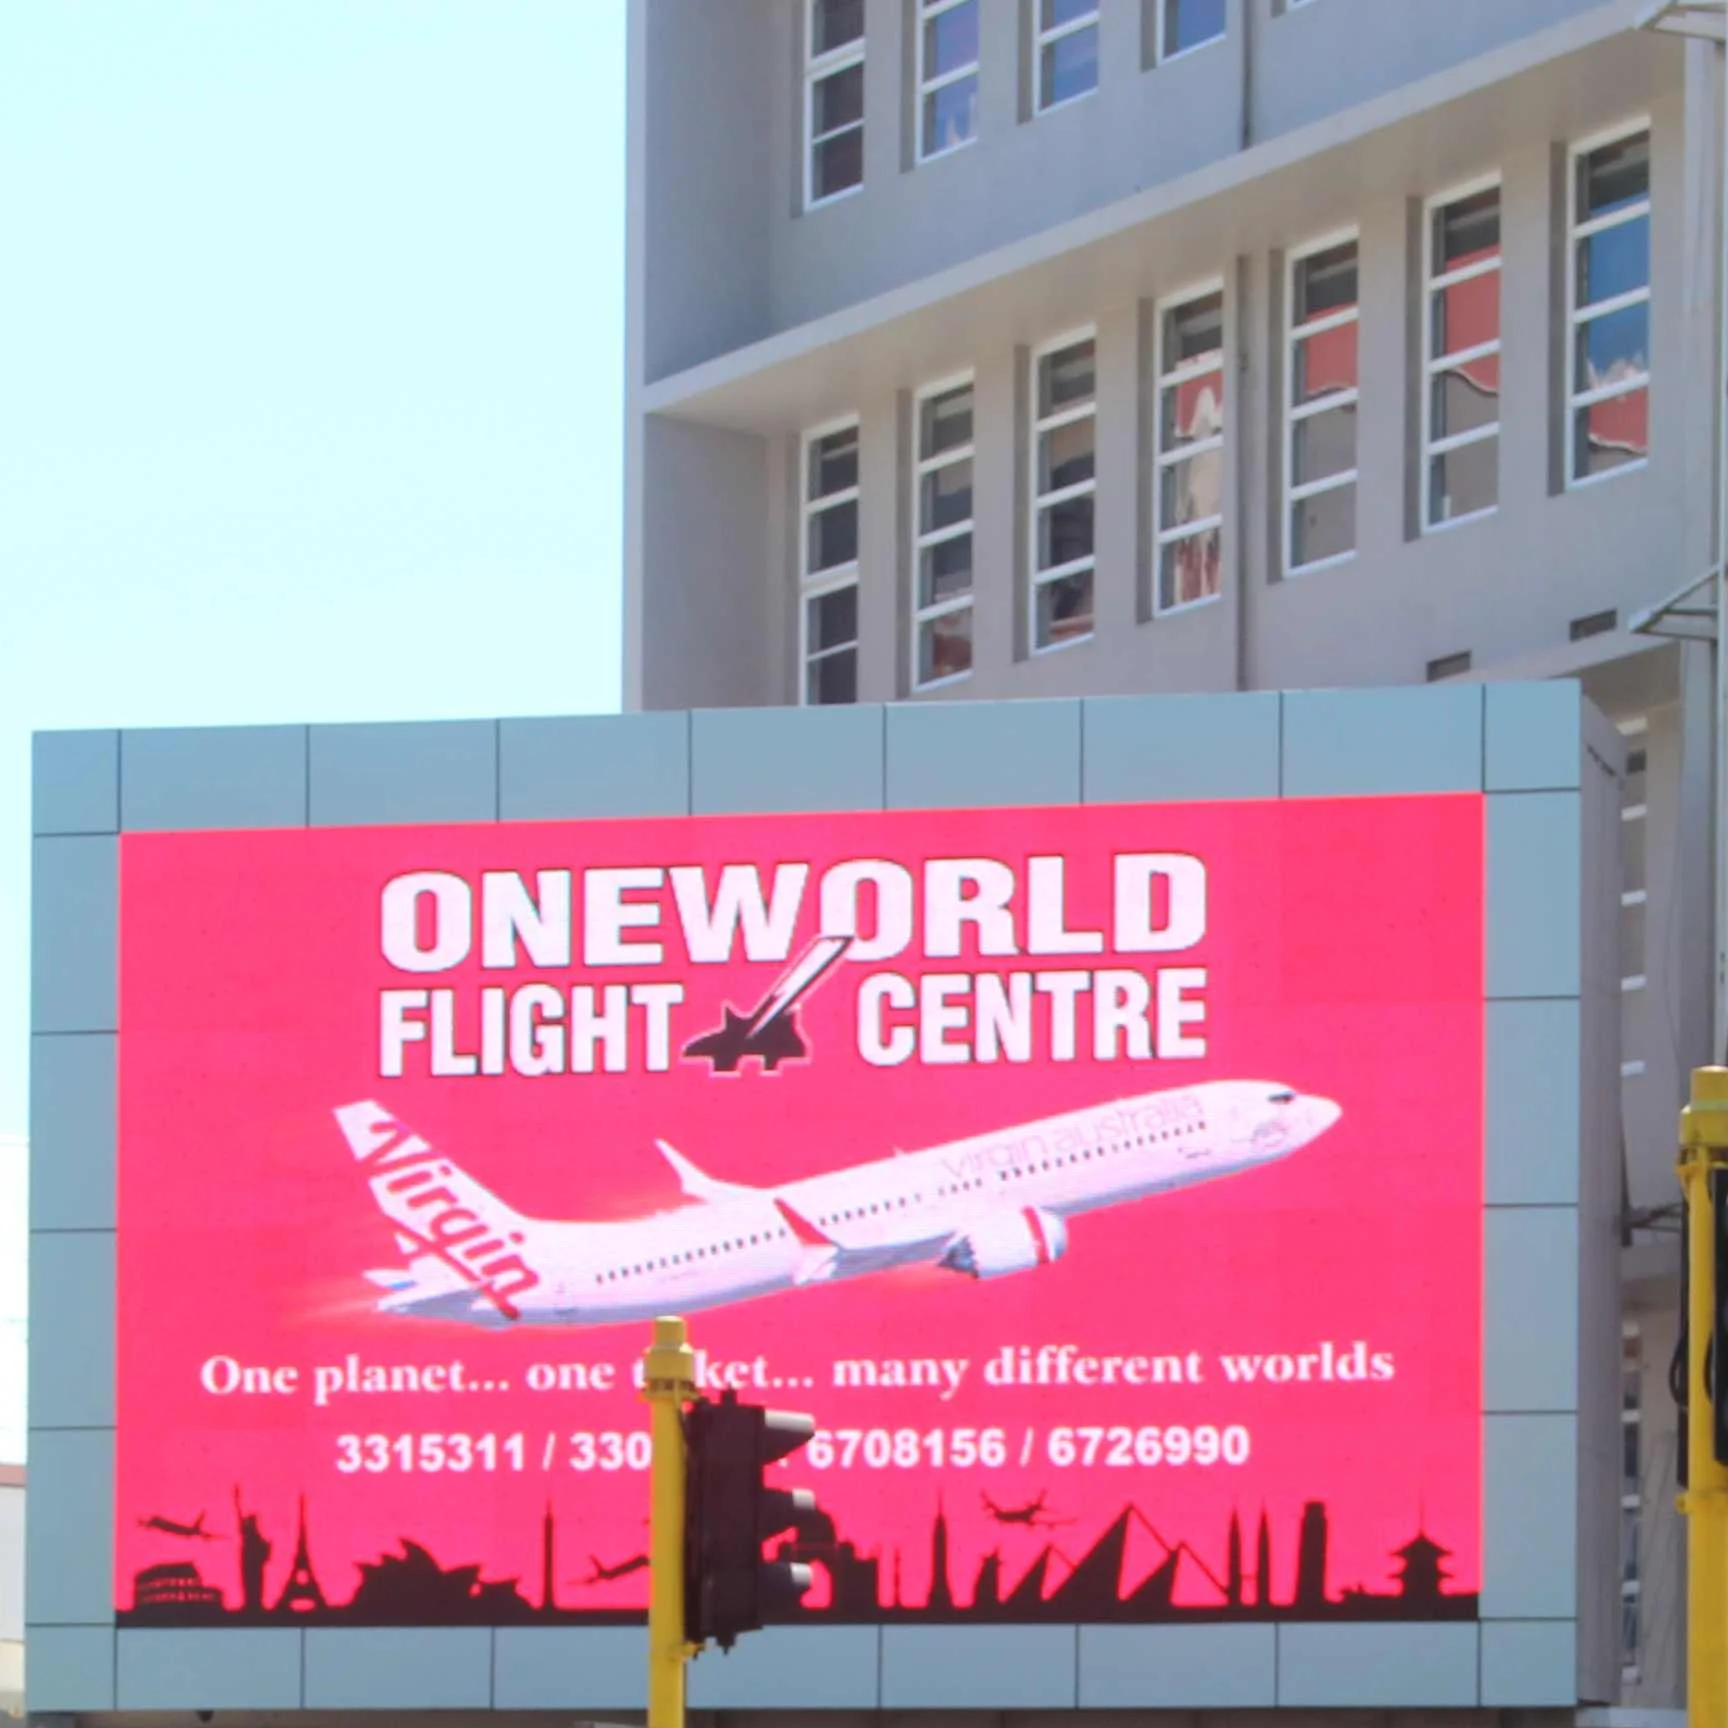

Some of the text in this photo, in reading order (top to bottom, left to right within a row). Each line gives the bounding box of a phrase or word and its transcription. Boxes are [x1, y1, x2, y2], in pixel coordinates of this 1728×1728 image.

[379, 852, 1207, 973] ONEWORLD
[378, 967, 1208, 1077] FLIGHT CENTRE
[362, 1121, 541, 1318] Virgin
[200, 1341, 1394, 1405] One planet... one tket... many different worlds
[335, 1433, 526, 1472] 3315311
[807, 1427, 1007, 1468] 6708156
[1047, 1425, 1250, 1465] 6726990
